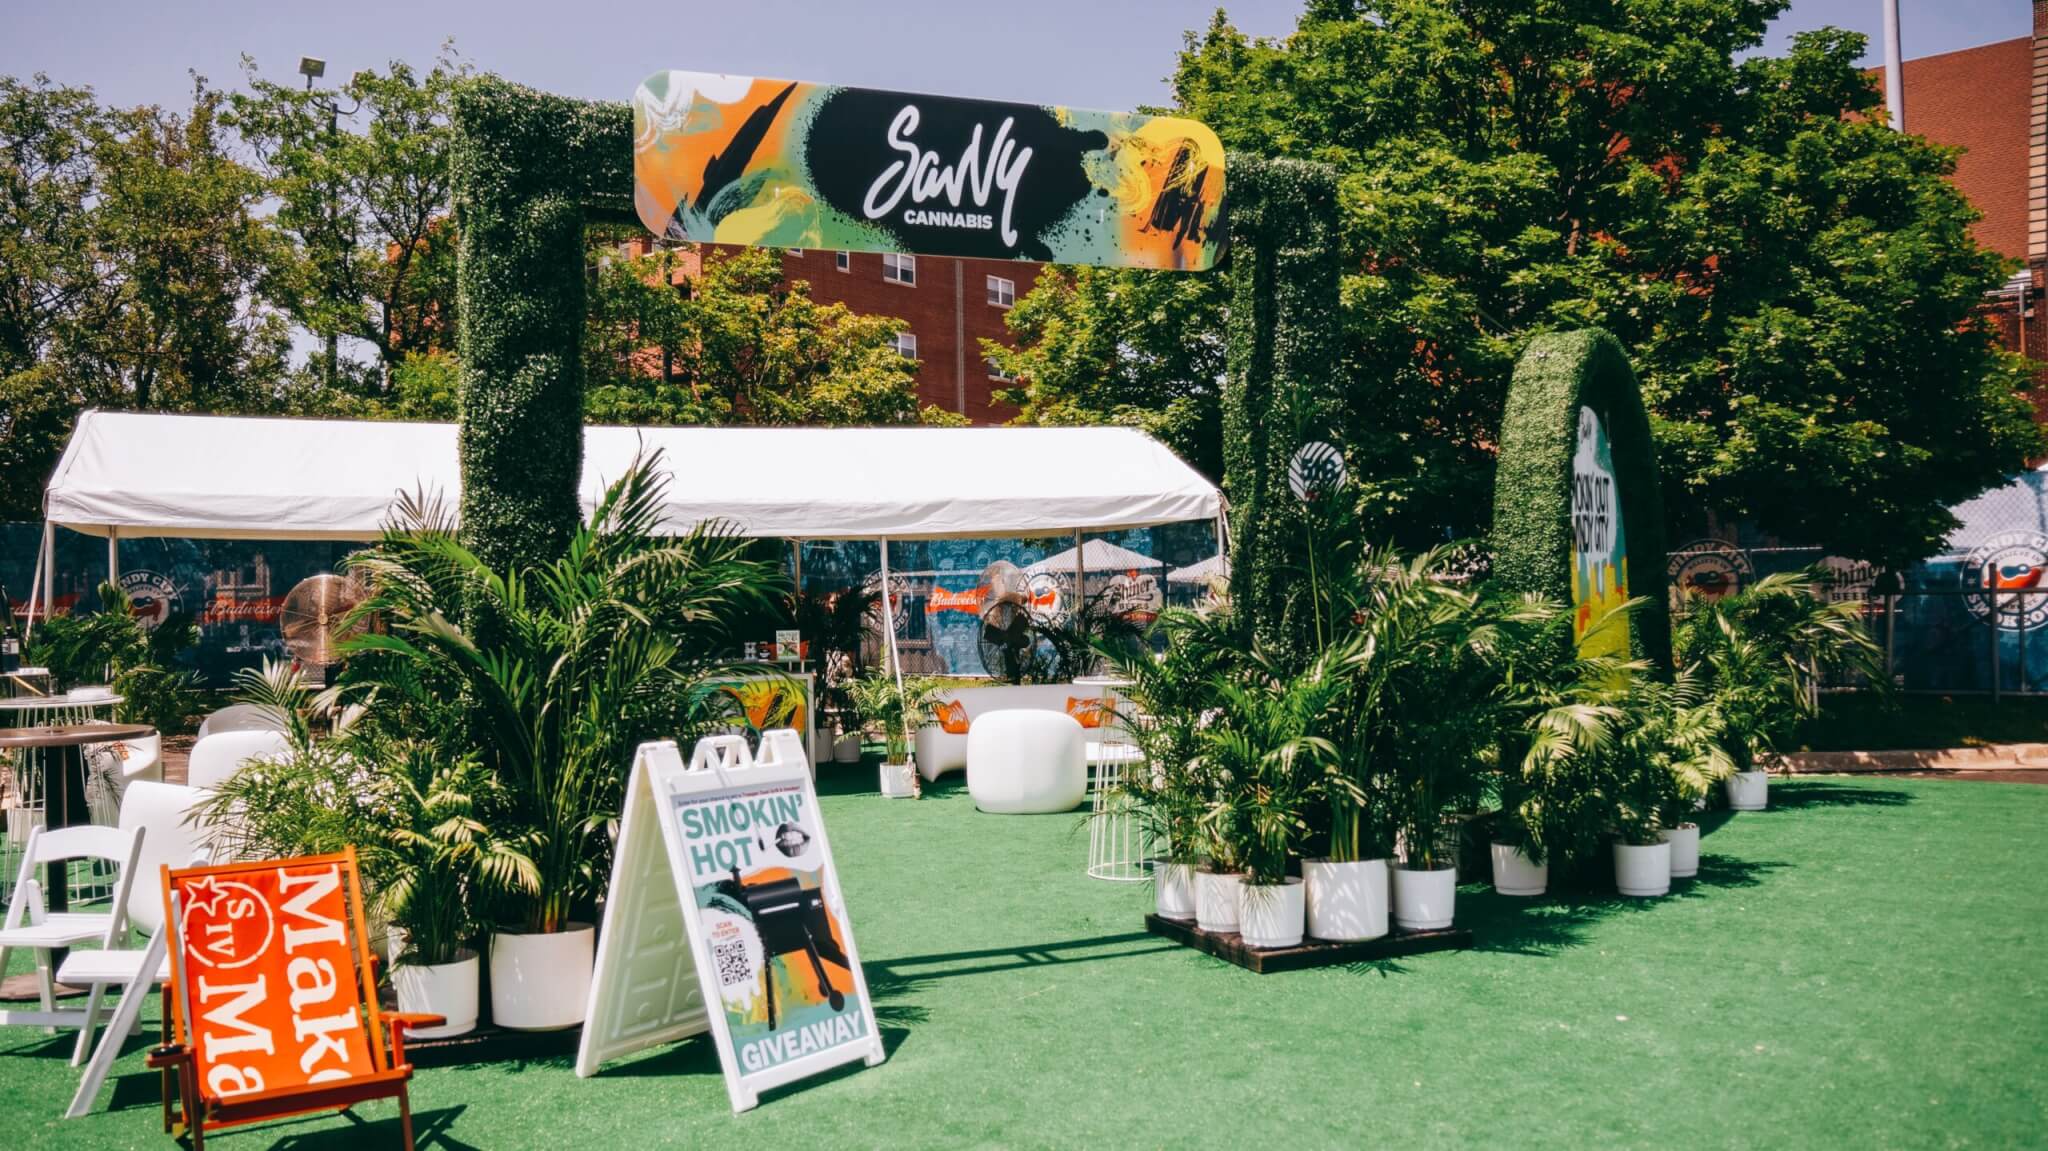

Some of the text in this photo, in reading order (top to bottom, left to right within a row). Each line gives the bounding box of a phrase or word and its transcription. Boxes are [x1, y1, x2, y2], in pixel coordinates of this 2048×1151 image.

[904, 209, 993, 230] CANNABIS
[120, 573, 149, 588] NDY
[682, 793, 802, 839] SMOKIN'
[690, 837, 752, 876] HOT
[741, 1010, 861, 1072] GIVEAWAY
